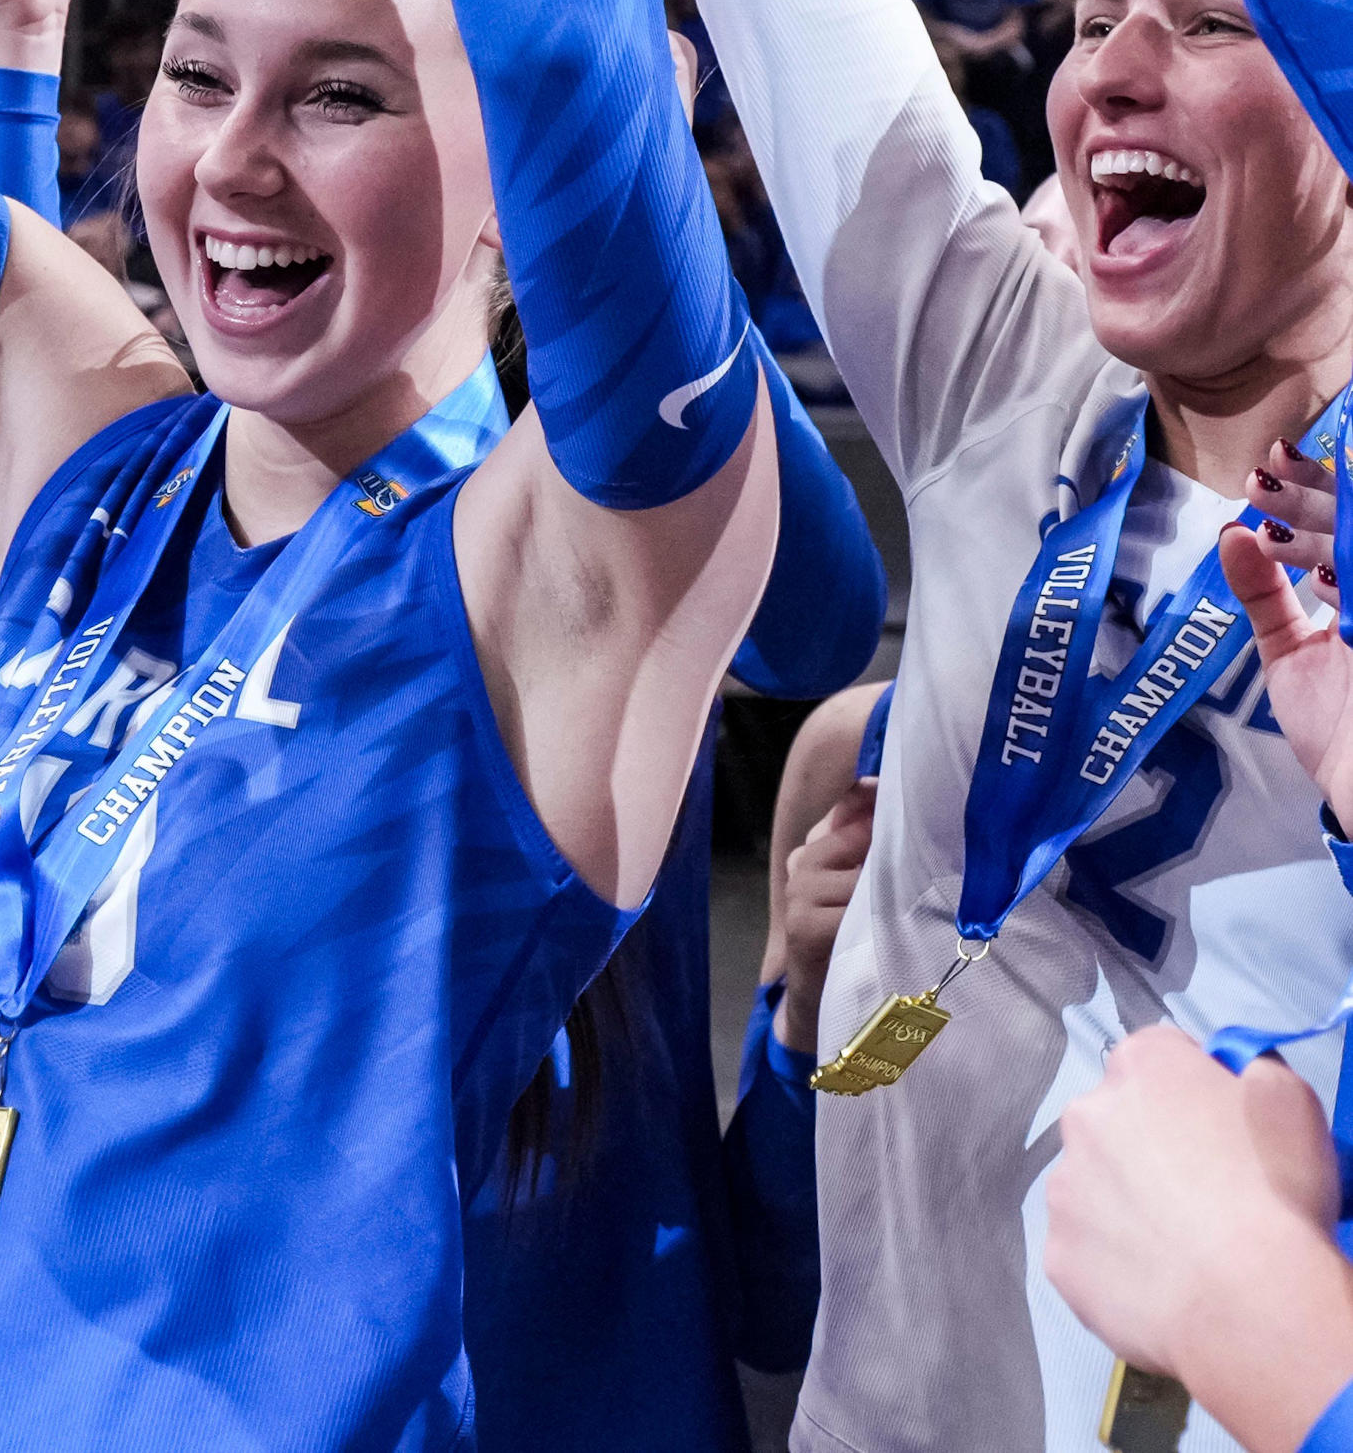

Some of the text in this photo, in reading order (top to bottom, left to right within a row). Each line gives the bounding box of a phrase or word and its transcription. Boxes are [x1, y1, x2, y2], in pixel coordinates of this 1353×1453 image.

[1001, 543, 1097, 767] VOLLEYBALL
[1079, 596, 1237, 786] CHAMPION
[77, 657, 247, 846] CHAMPION
[850, 1050, 906, 1081] CHAMPION
